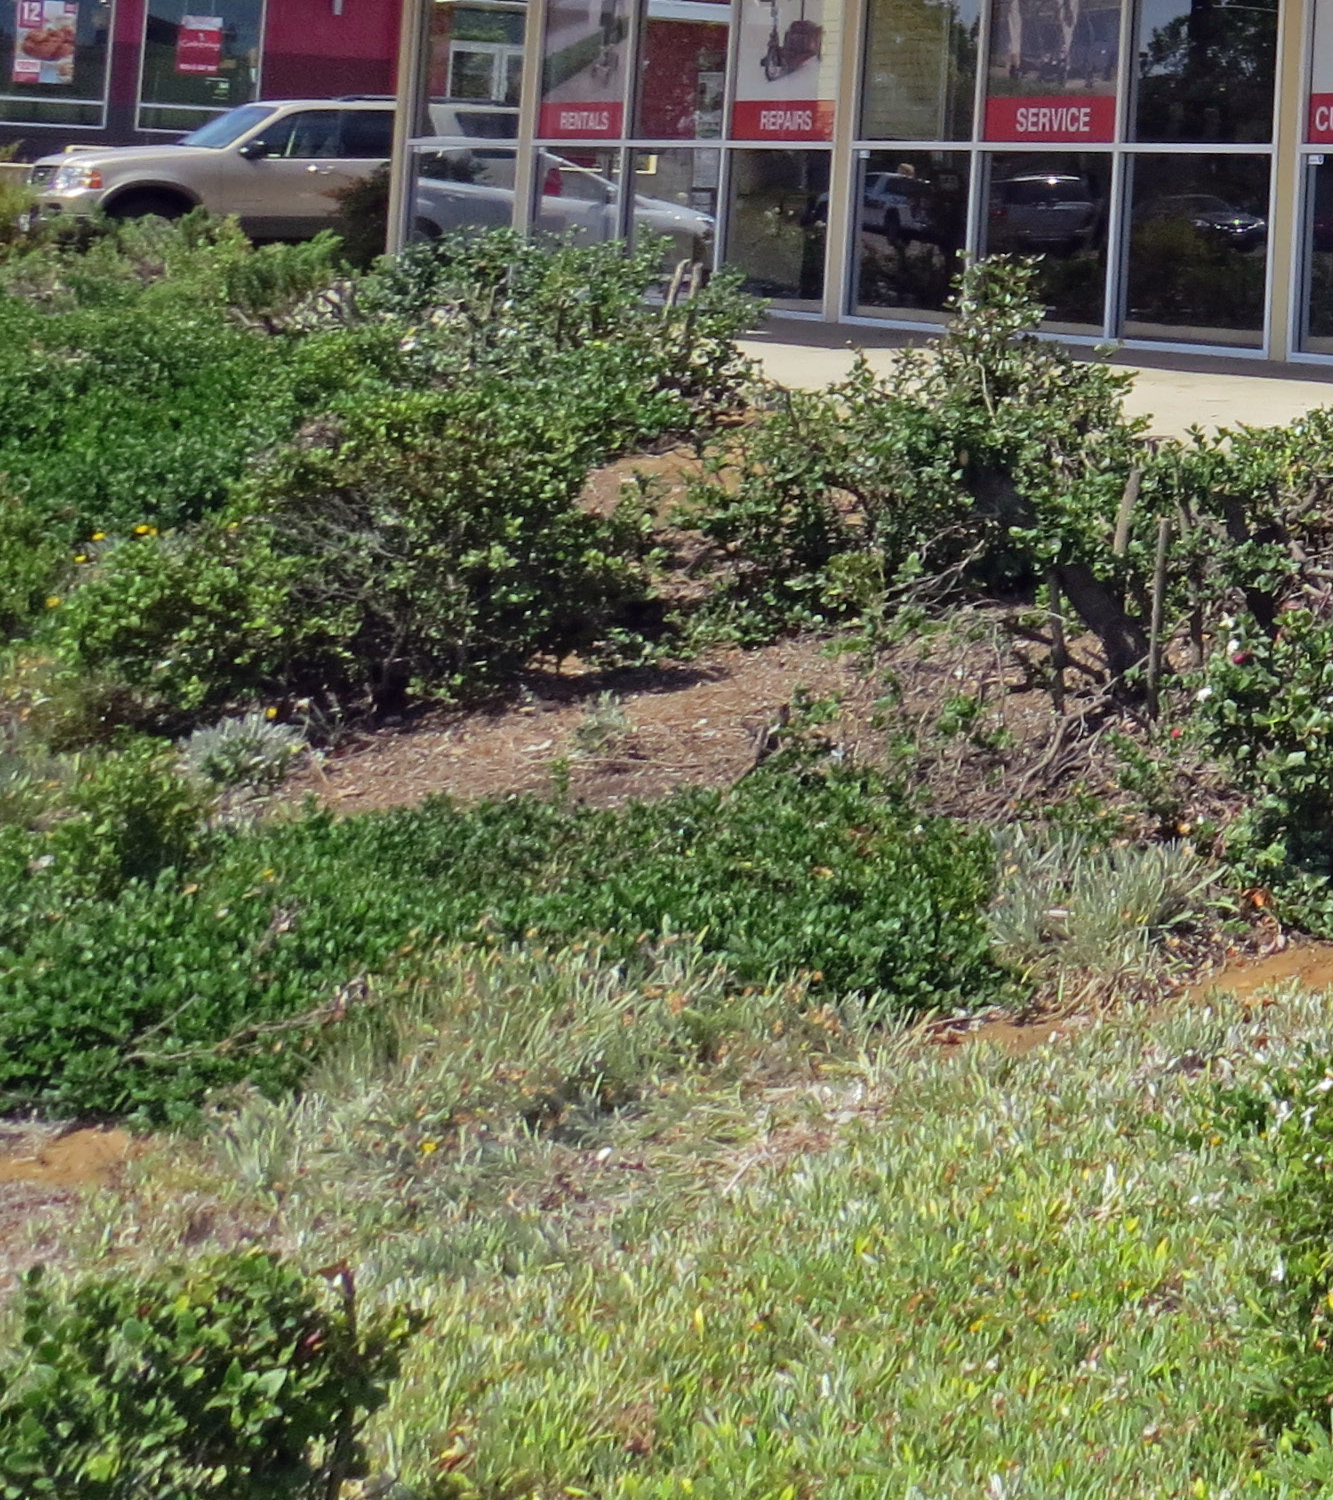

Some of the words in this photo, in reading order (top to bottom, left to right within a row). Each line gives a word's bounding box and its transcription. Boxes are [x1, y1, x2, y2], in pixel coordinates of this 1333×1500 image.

[22, 1, 42, 22] 12
[559, 110, 610, 131] RENTALS
[760, 109, 812, 131] REPAIRS
[1015, 106, 1091, 133] SERVICE
